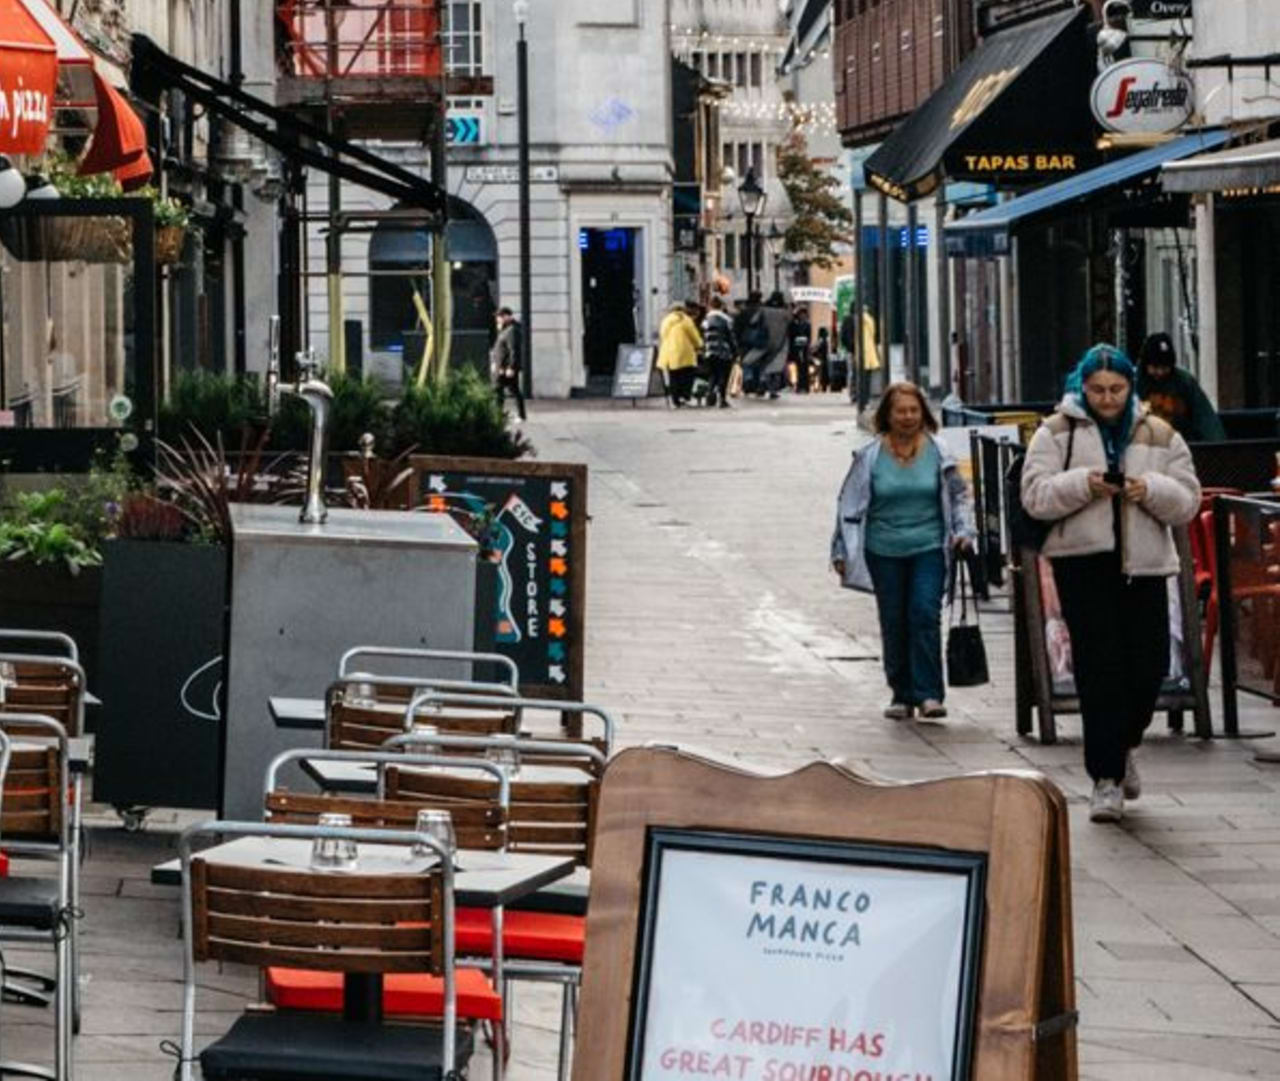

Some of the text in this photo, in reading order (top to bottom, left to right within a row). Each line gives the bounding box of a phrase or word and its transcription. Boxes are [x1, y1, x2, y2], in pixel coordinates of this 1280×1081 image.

[1105, 75, 1188, 118] Segafredo
[965, 154, 1076, 171] TAPAS BAR
[525, 542, 540, 638] STORE
[749, 880, 871, 914] FRANCO
[746, 911, 862, 947] MANCA
[710, 1018, 885, 1058] CARDIFF HAS
[660, 1048, 933, 1081] GREAT SOURD
